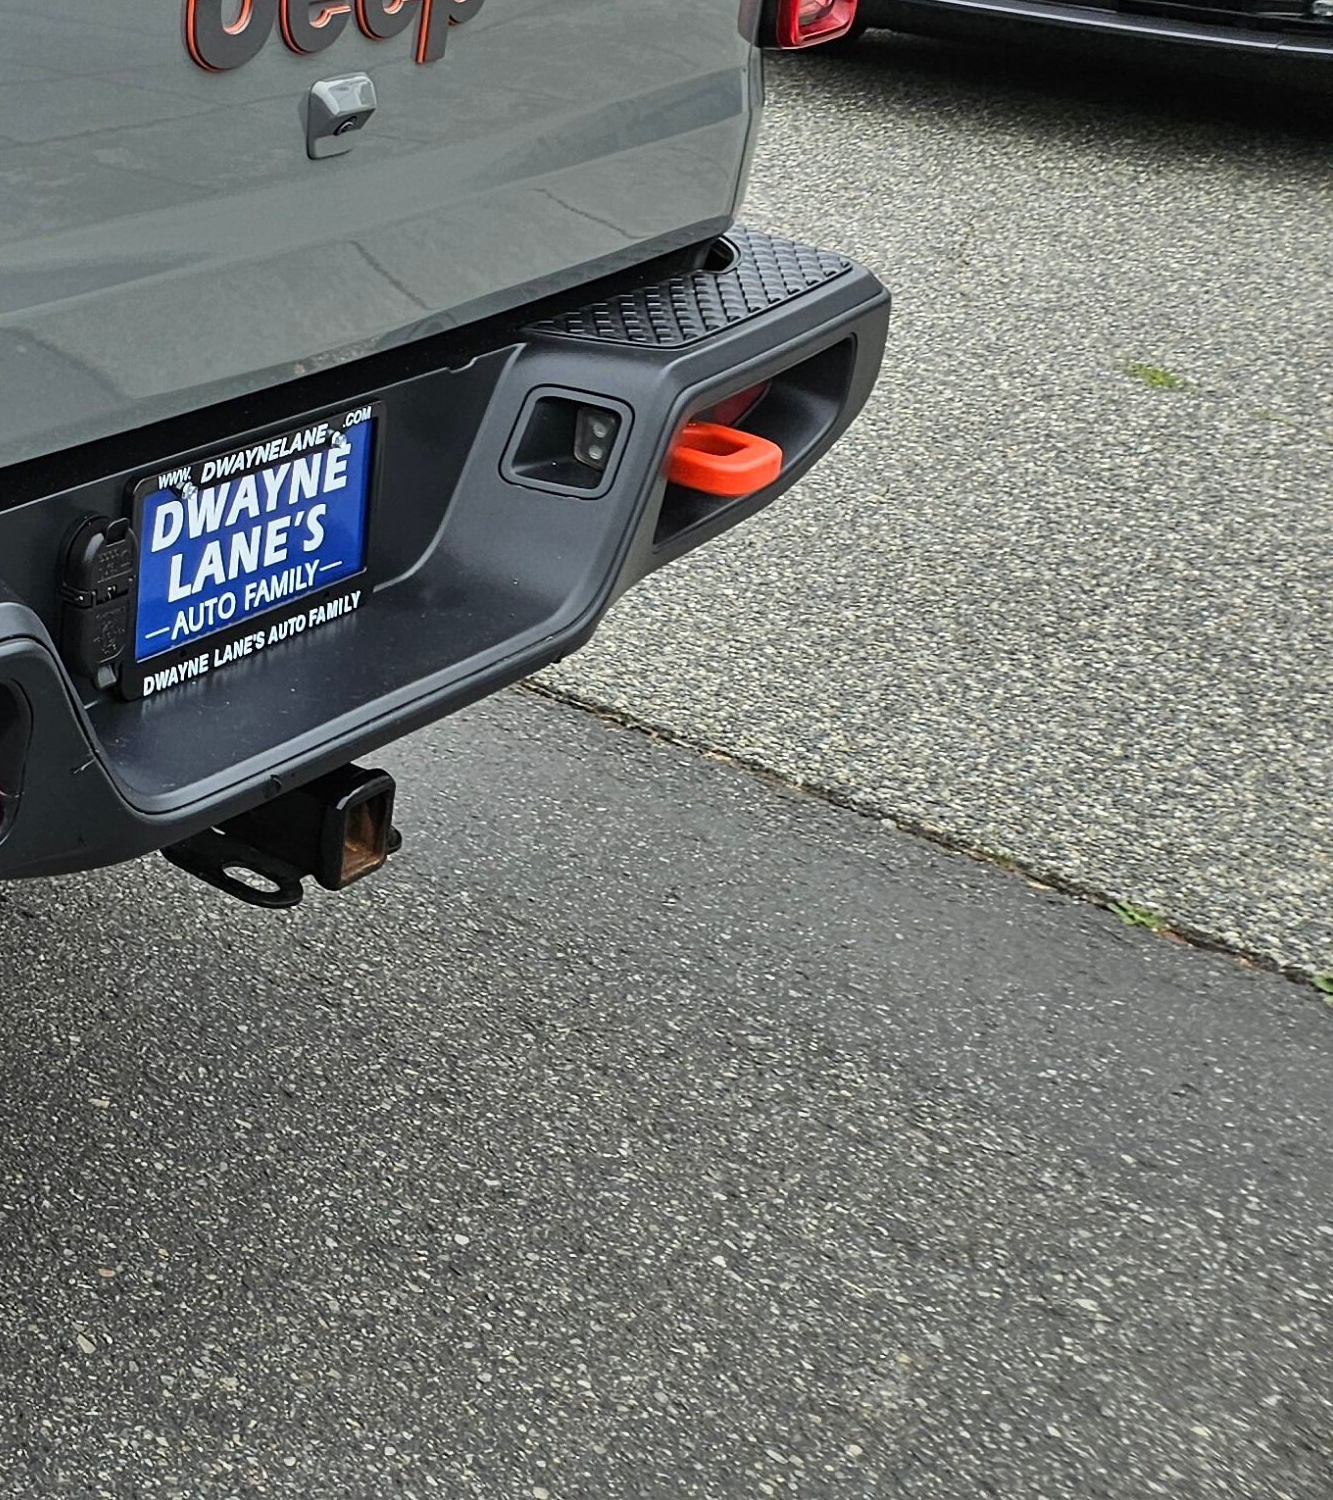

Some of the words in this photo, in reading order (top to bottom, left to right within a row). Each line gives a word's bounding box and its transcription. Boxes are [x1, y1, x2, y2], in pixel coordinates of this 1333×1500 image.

[151, 442, 352, 553] DWAYNE
[158, 466, 192, 490] WWW.
[200, 423, 329, 484] DWAYNELANE
[342, 405, 372, 429] .COM
[168, 503, 326, 603] LANE'S
[171, 591, 237, 640] AUTO
[244, 560, 321, 609] FAMILY
[143, 655, 209, 697] DWAYNE
[213, 630, 265, 667] LANE'S
[267, 615, 306, 646] AUTO
[308, 590, 362, 628] FAMILY
